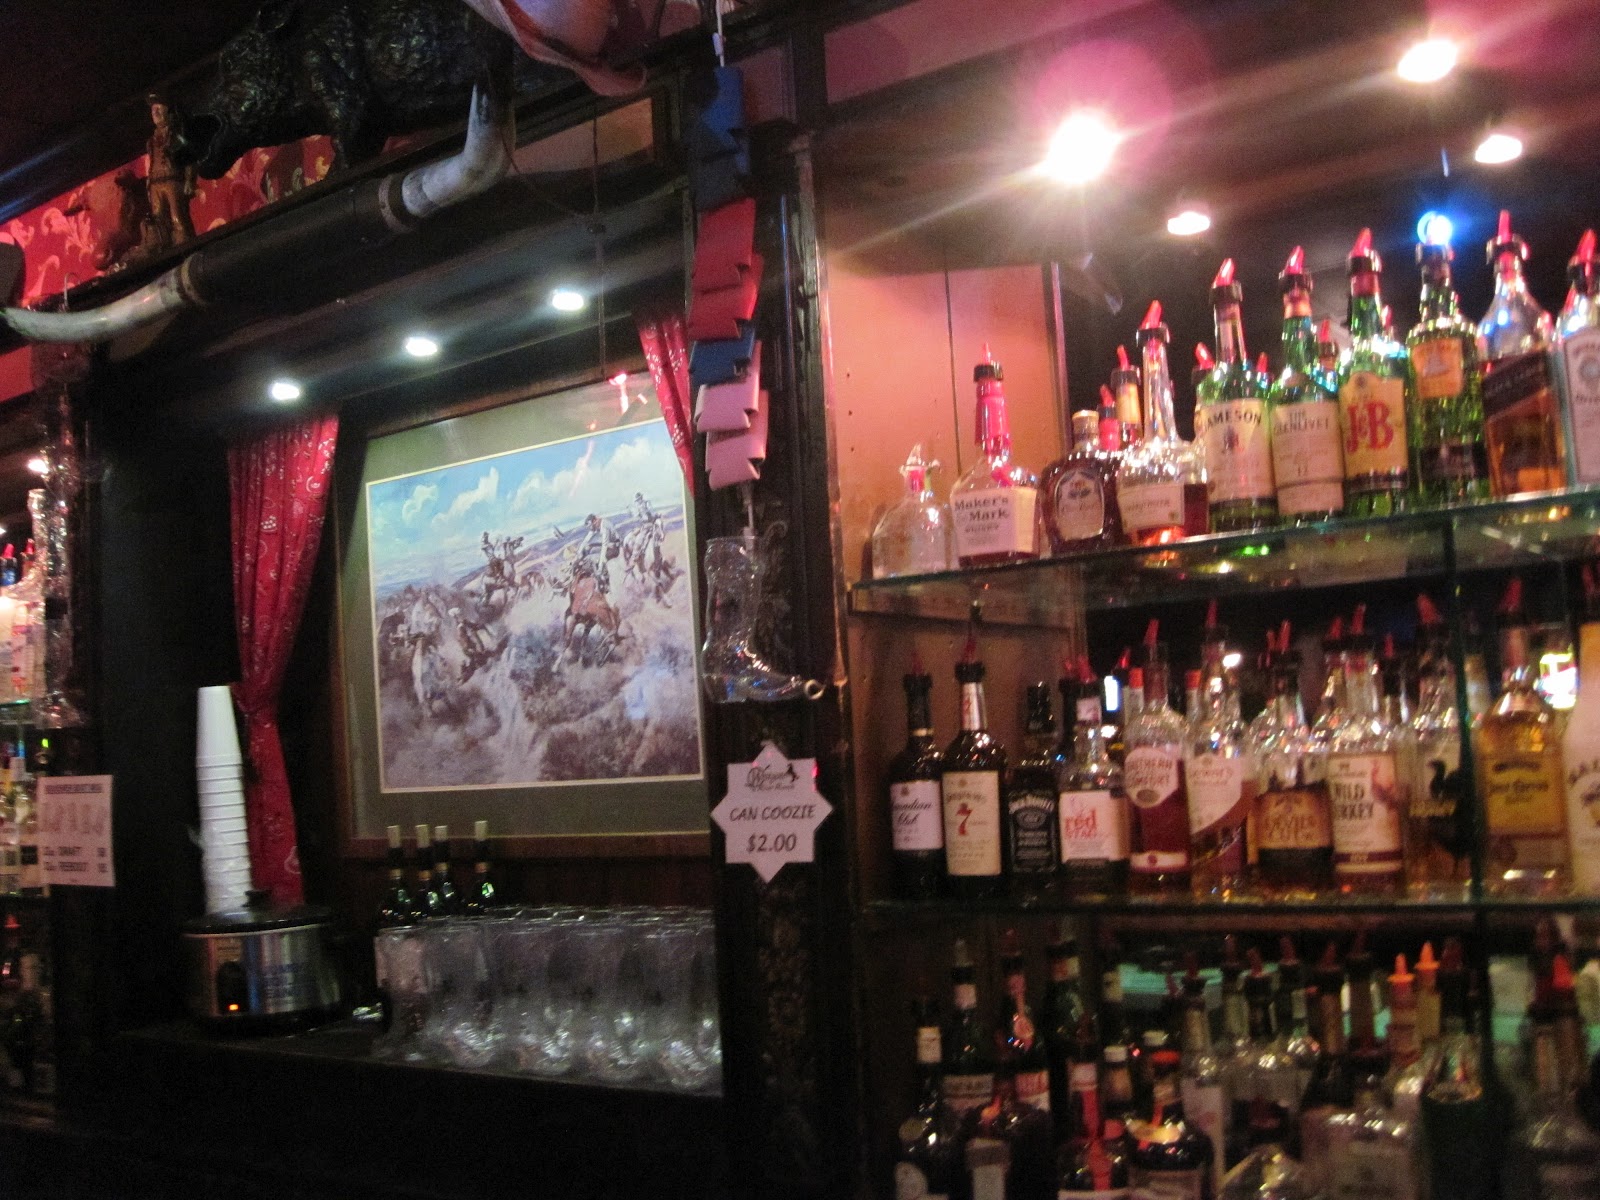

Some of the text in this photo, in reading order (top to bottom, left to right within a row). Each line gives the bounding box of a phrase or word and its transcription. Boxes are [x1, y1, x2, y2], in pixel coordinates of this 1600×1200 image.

[729, 803, 817, 822] CAN COOZIE
[746, 832, 798, 854] $2.00
